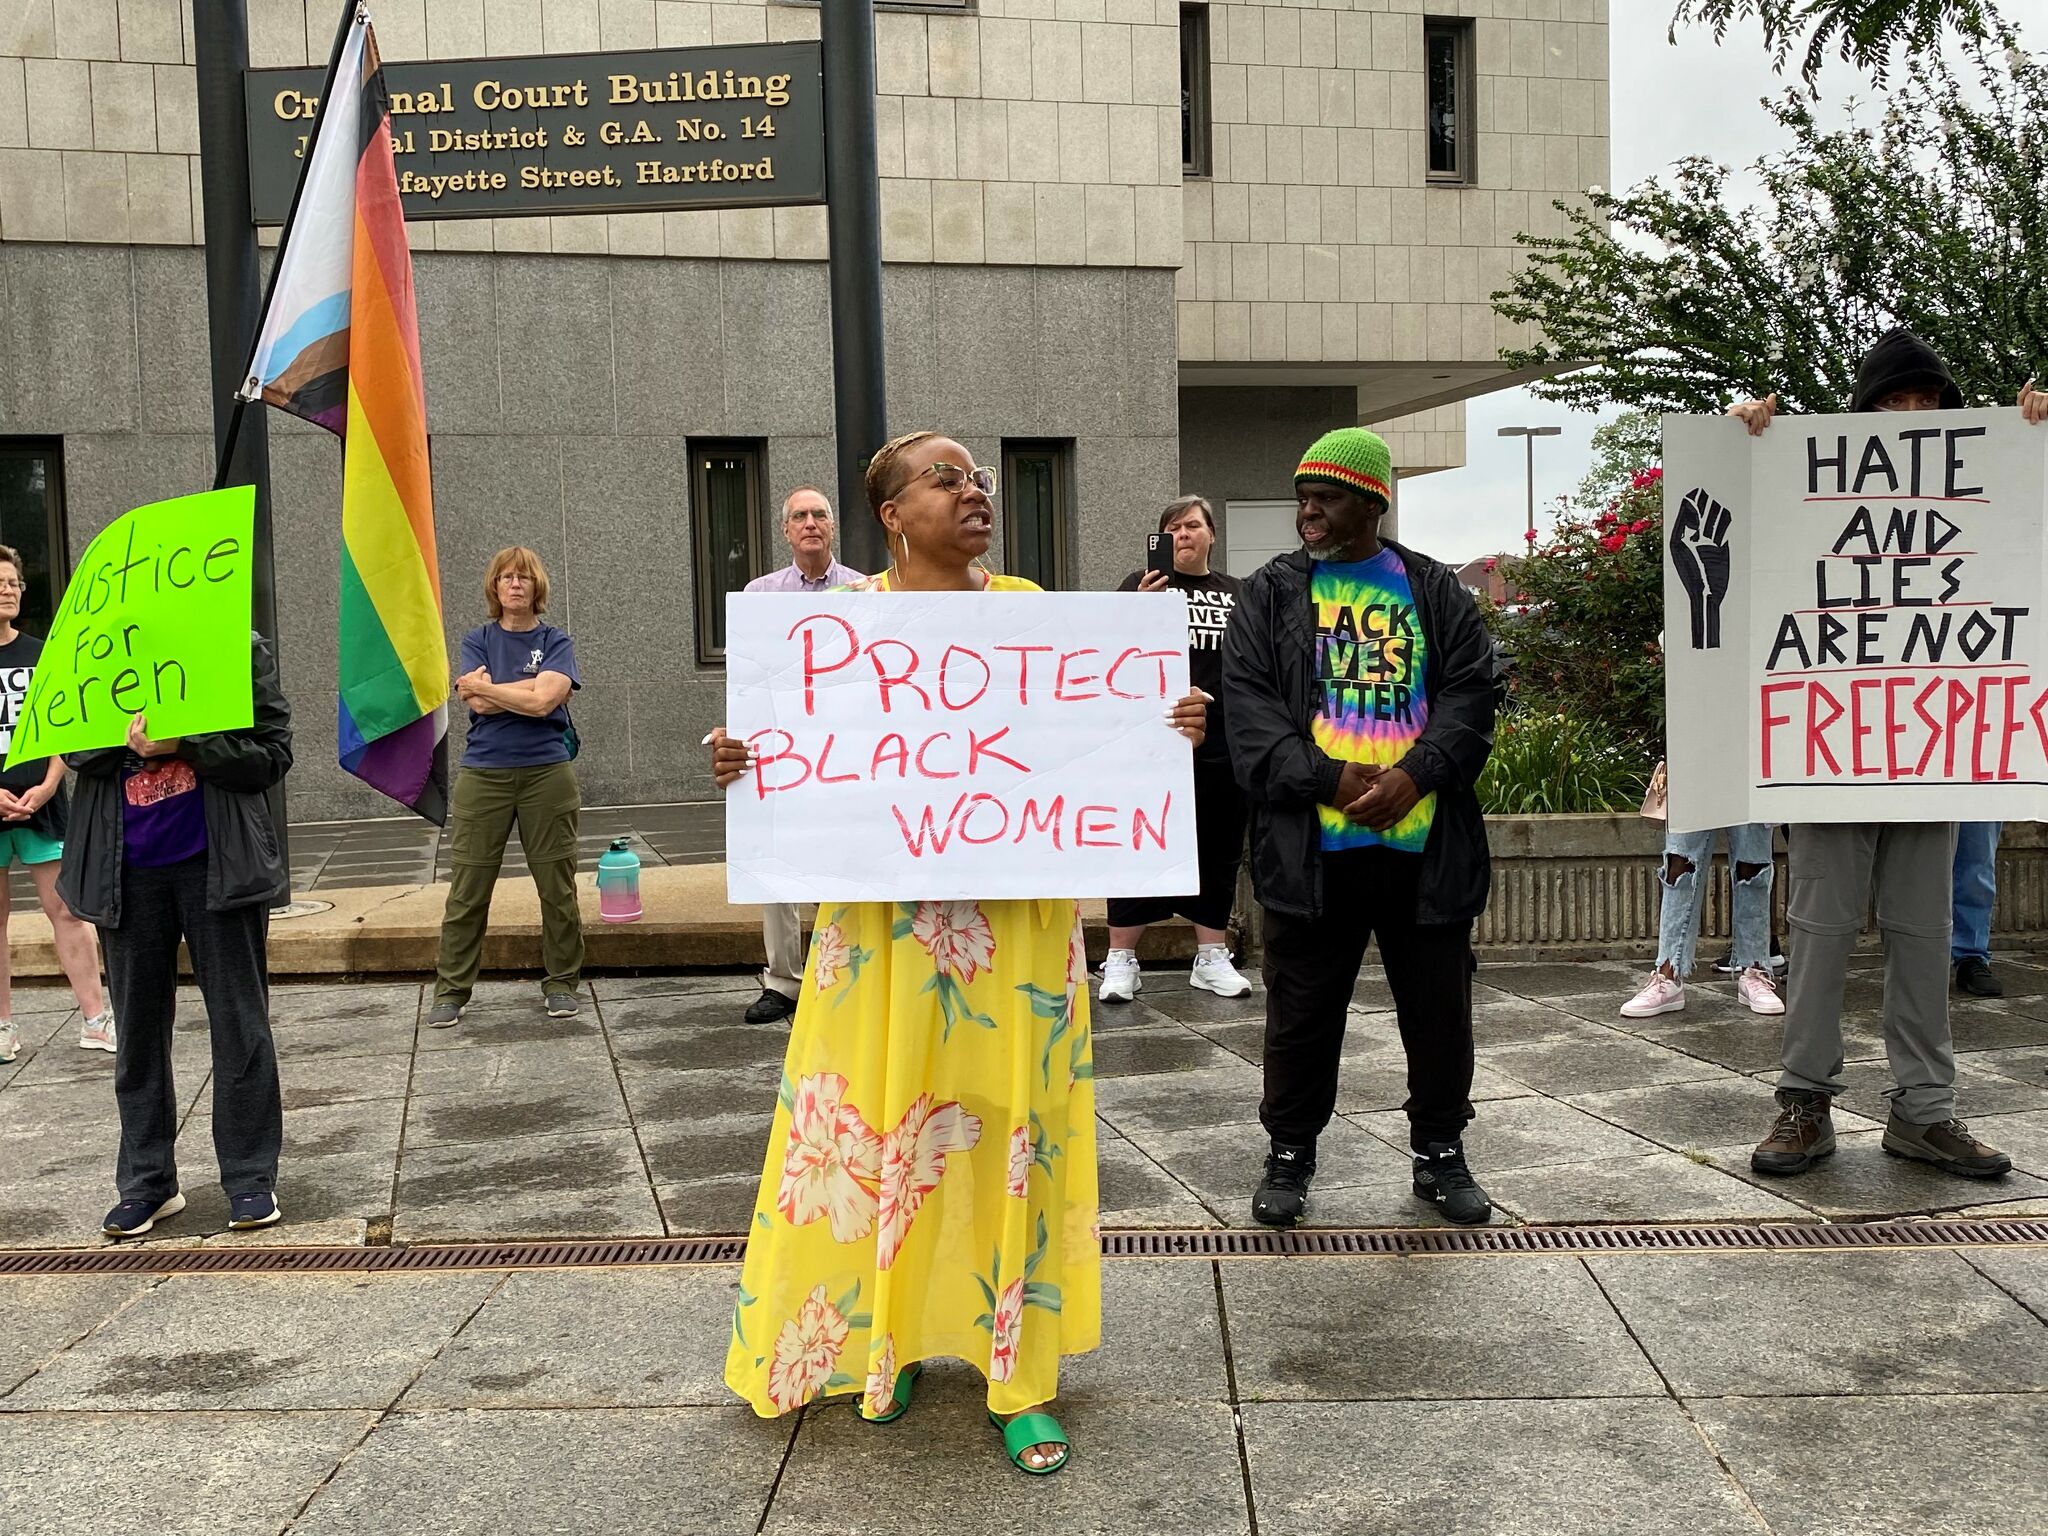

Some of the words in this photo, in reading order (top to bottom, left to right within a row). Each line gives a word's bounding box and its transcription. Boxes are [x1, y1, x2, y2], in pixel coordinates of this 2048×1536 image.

[274, 83, 455, 120] Crnal
[473, 79, 588, 111] Court
[607, 70, 792, 106] Building
[428, 126, 548, 153] District
[563, 125, 586, 146] &
[600, 120, 662, 144] G.A.
[676, 118, 727, 141] No.
[740, 115, 776, 139] 14
[400, 170, 507, 198] fayette
[520, 164, 623, 189] Street,
[635, 157, 775, 184] Hartford
[1807, 426, 1986, 498] HATE
[1831, 505, 1962, 556] AND
[50, 520, 240, 641] Justice
[1816, 556, 1965, 609] LIES
[1313, 603, 1416, 641] LACK
[787, 613, 1183, 716] PROTECT
[1315, 636, 1409, 684] IVES
[18, 659, 187, 754] Keren
[1316, 681, 1413, 725] ATTER
[746, 726, 1032, 800] BLACK
[892, 790, 1172, 858] WOMEN
